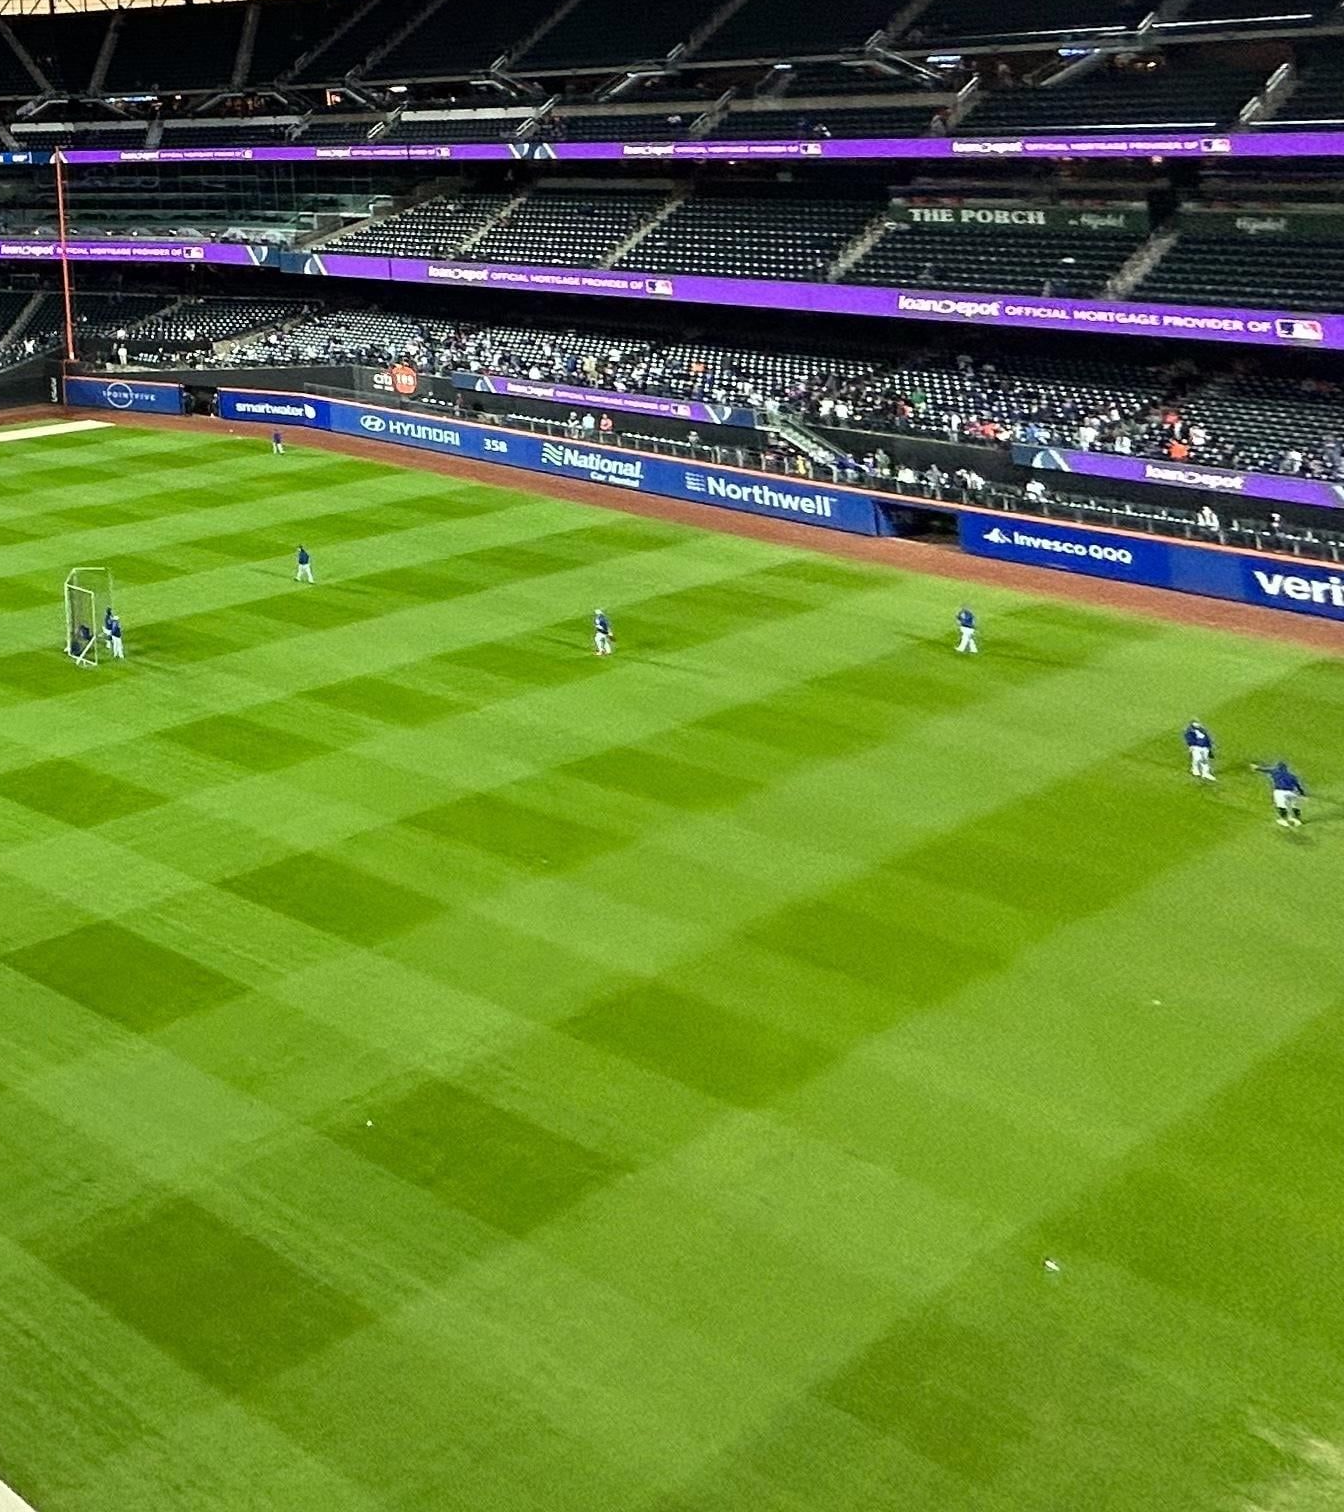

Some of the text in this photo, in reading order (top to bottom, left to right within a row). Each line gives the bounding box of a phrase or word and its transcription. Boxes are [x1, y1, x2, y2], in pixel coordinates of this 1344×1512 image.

[909, 208, 1045, 226] THE PORCH
[898, 295, 1272, 333] loanDepot OFFICIAL MORTGAGE PROVIDER OF
[236, 402, 305, 417] smartwater
[388, 420, 460, 446] HYUNDAI
[484, 438, 508, 453] 358
[563, 447, 643, 479] National
[707, 476, 832, 517] Northwell
[1013, 531, 1133, 564] Invesco QQQ
